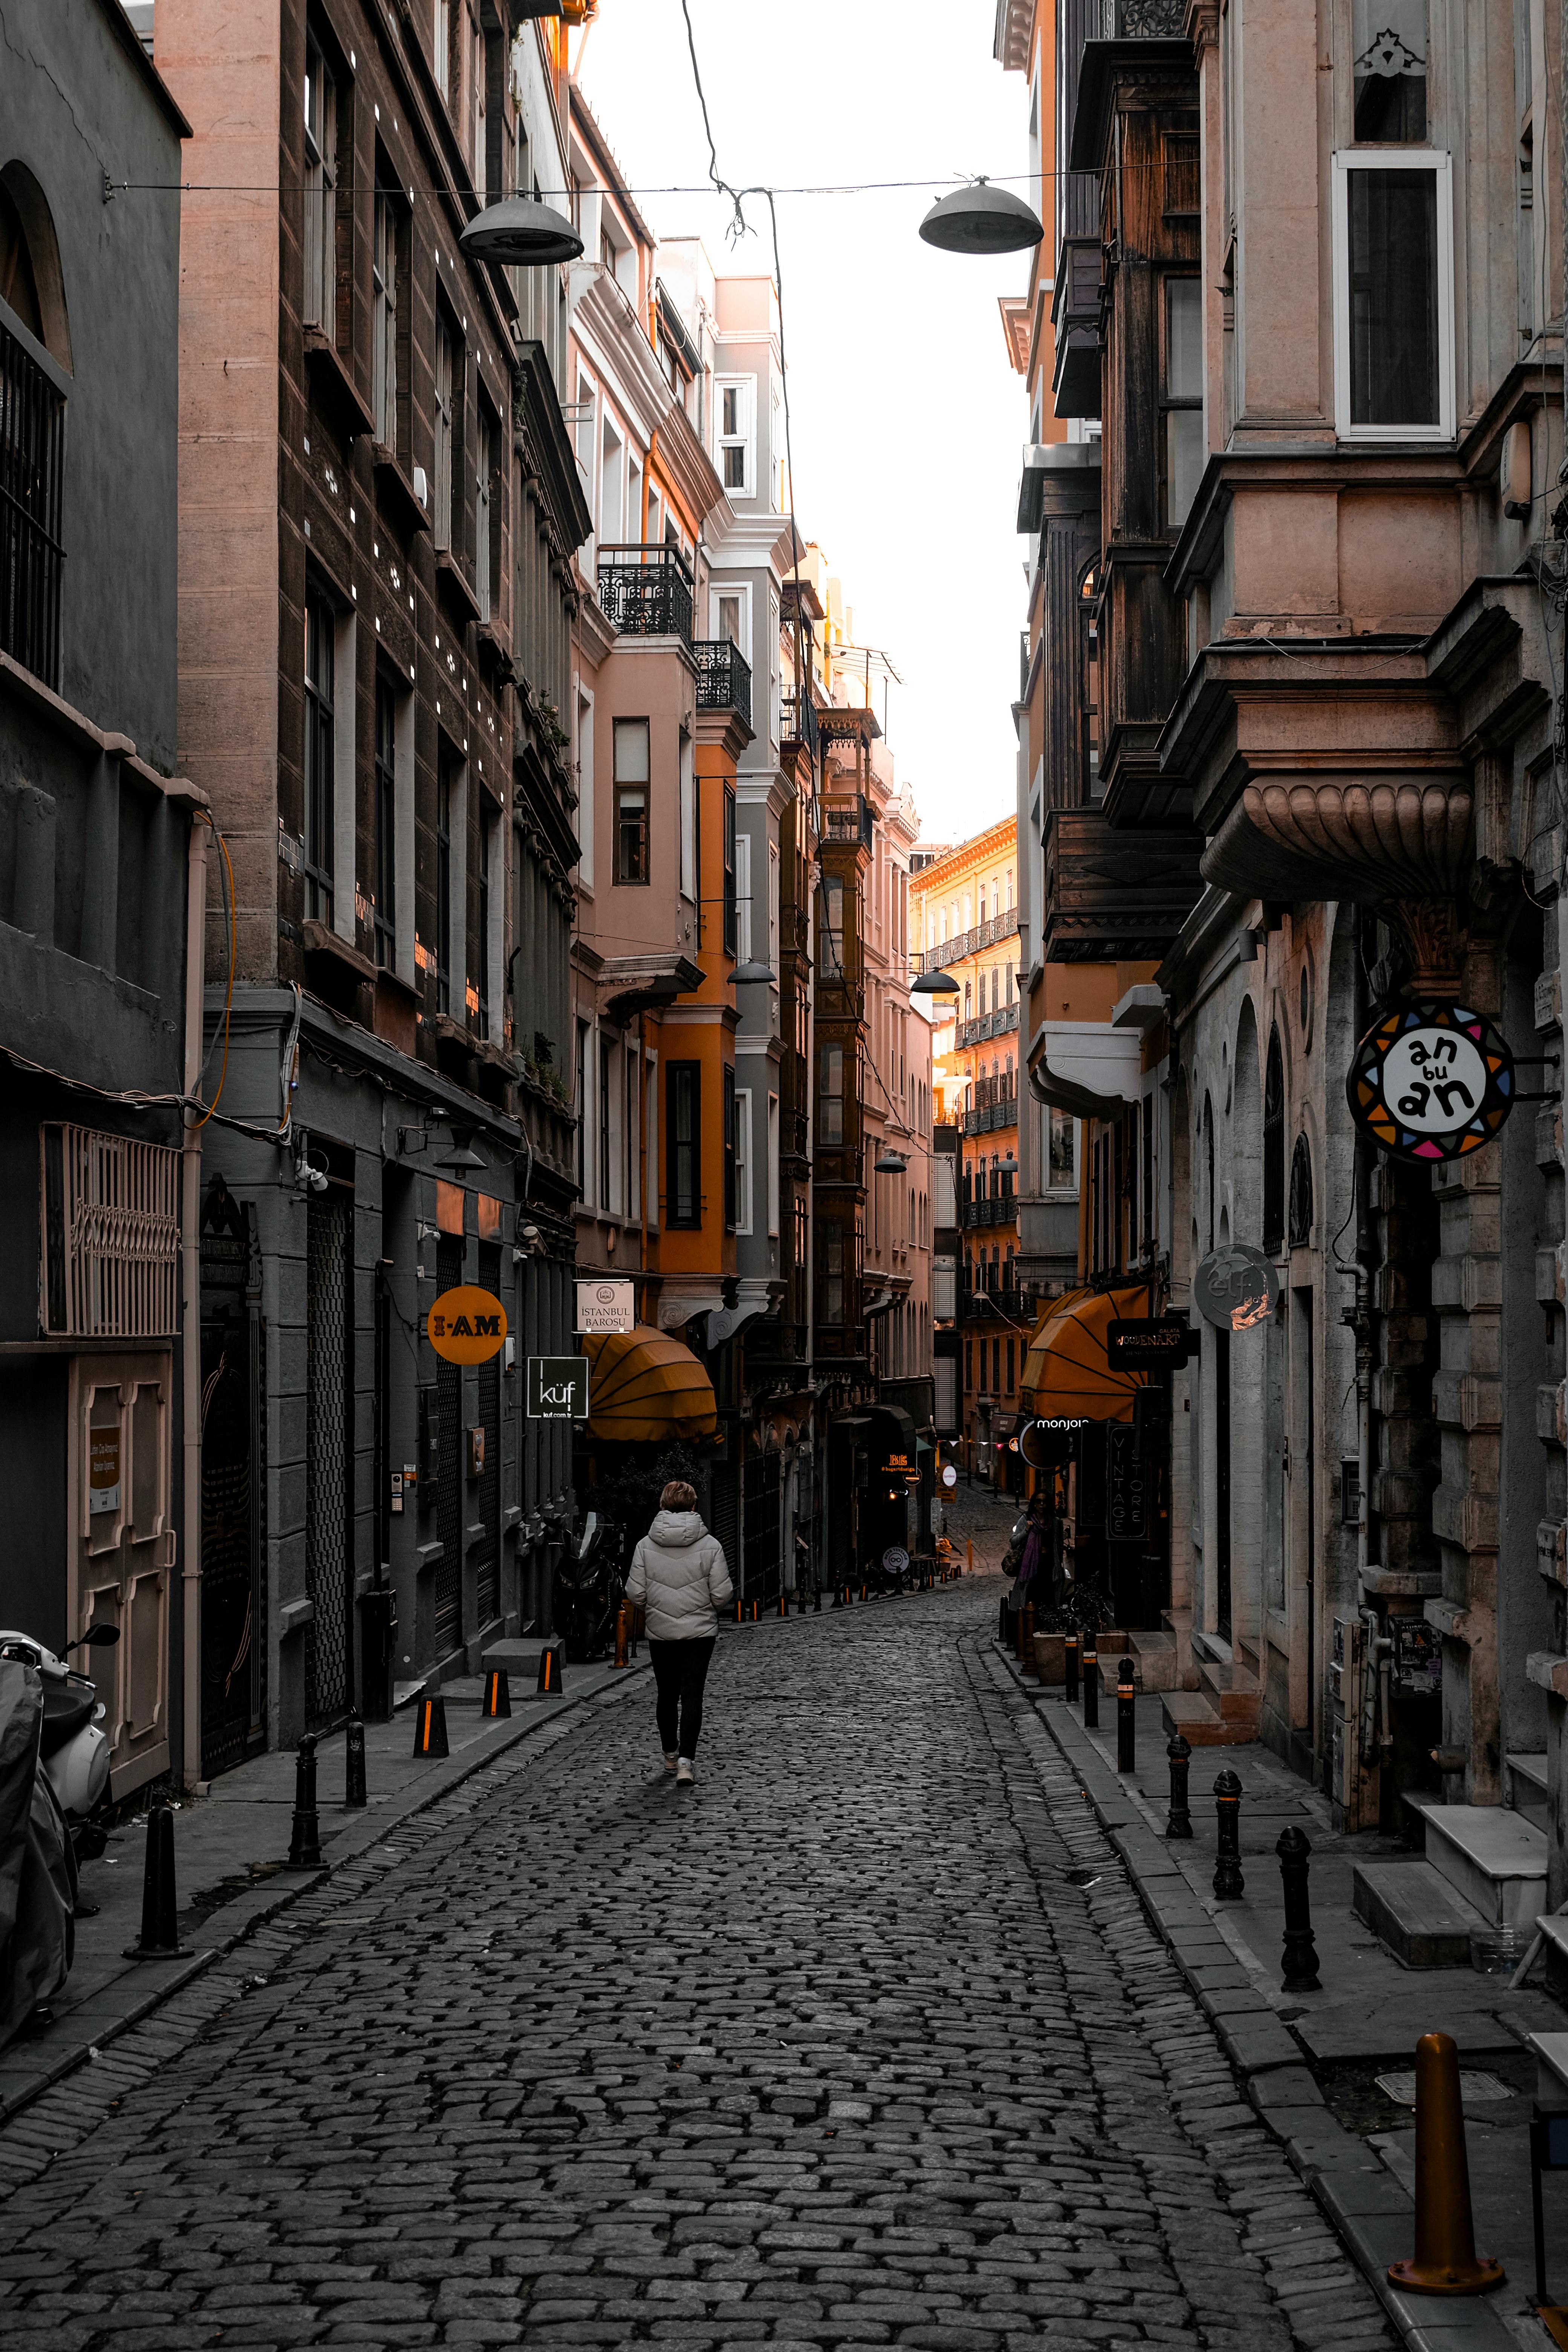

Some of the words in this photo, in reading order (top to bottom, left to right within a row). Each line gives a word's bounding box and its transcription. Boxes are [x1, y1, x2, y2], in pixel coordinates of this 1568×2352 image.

[1409, 1037, 1457, 1065] an
[1423, 1065, 1448, 1081] bu
[1398, 1080, 1475, 1118] an
[1208, 1271, 1250, 1304] elf
[582, 1306, 630, 1316] İSTANBUL
[434, 1315, 501, 1336] I-AM
[1115, 1334, 1180, 1346] WOODENART
[540, 1381, 576, 1411] küf
[1112, 1438, 1125, 1531] VINTAGE
